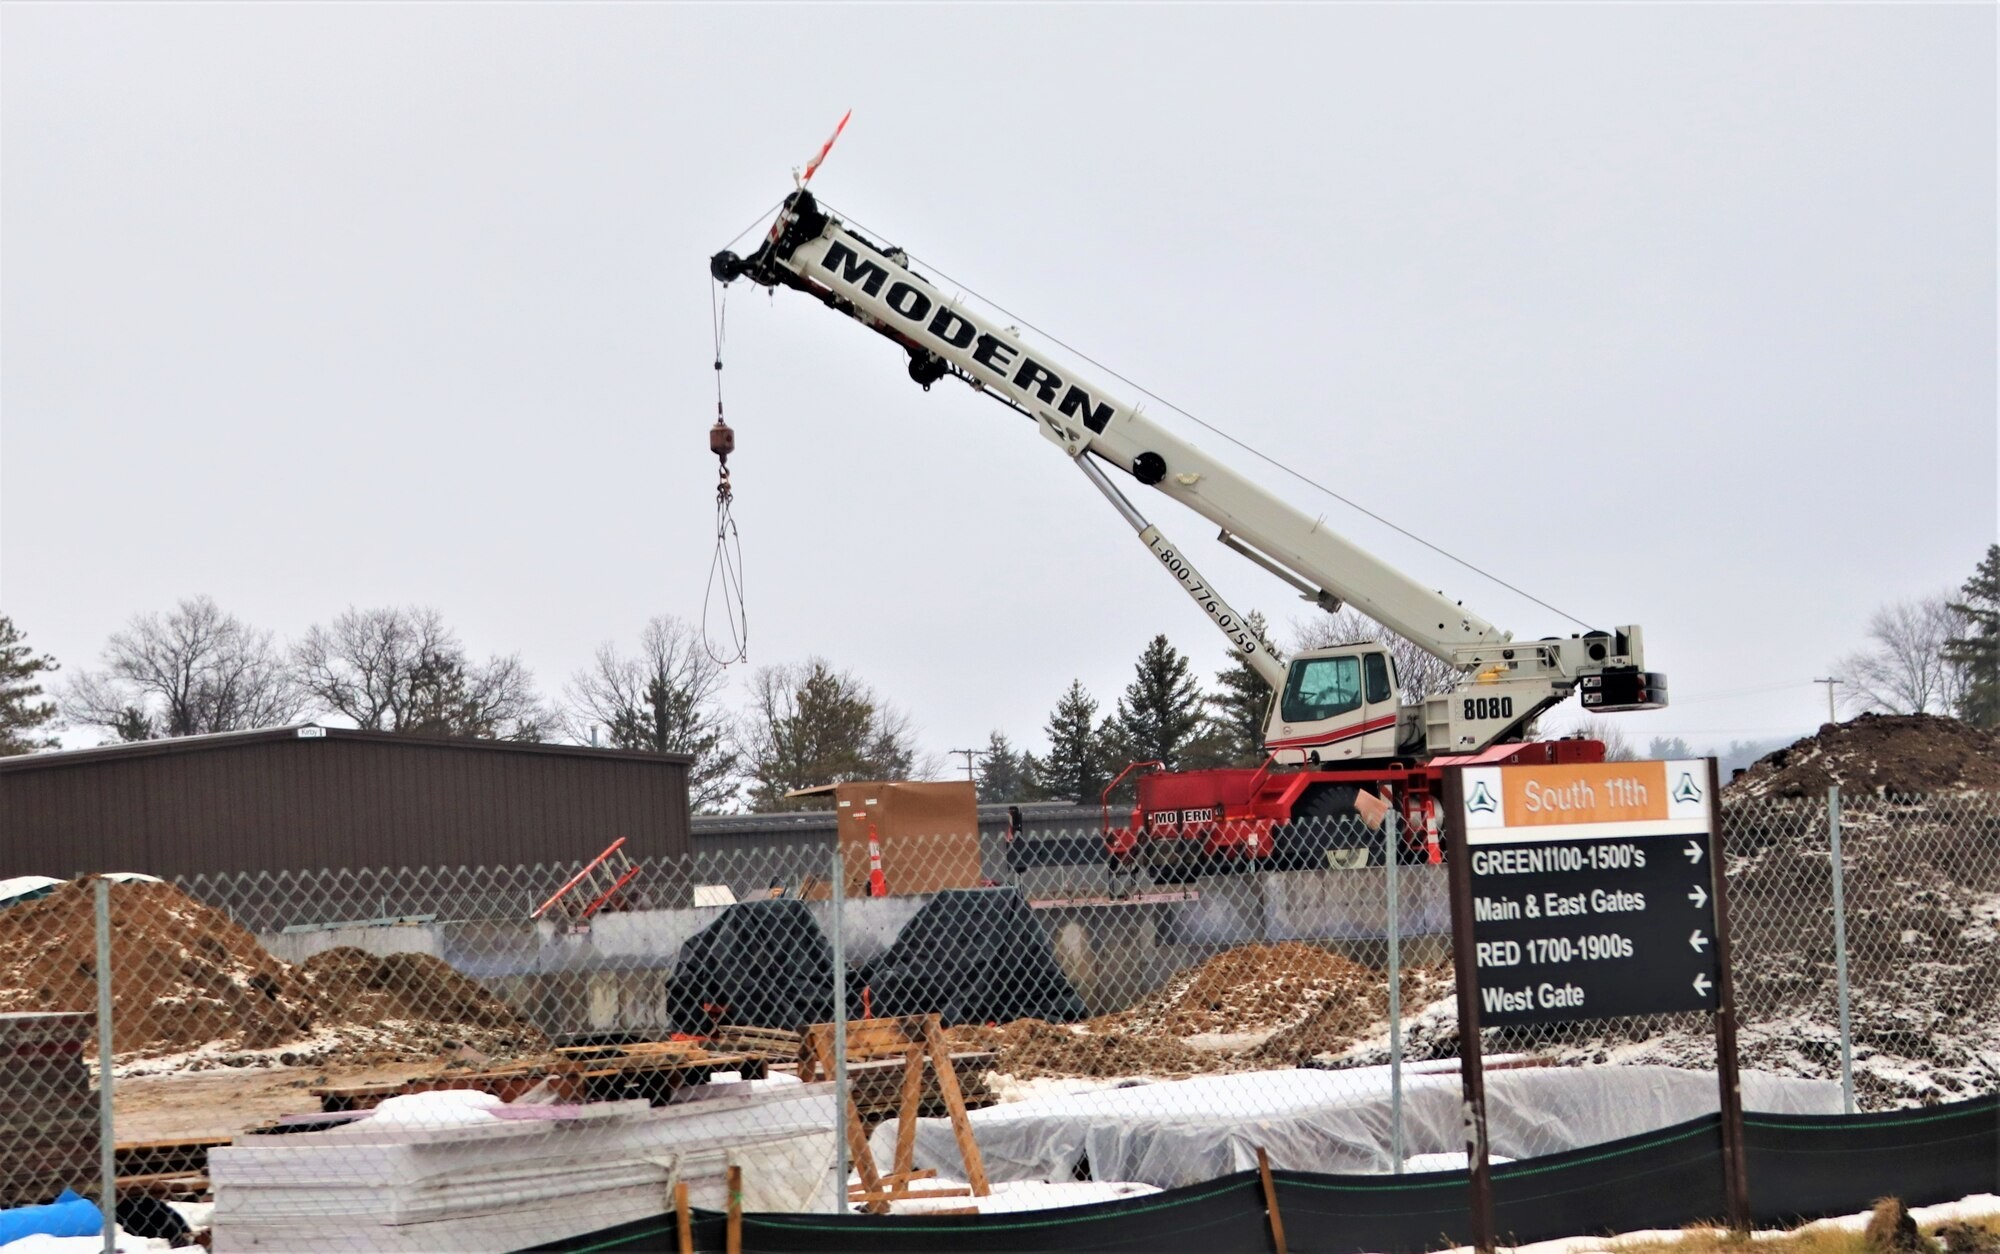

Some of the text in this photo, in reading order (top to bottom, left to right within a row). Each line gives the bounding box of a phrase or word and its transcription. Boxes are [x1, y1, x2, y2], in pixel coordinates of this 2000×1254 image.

[820, 239, 1116, 436] MODERN
[1149, 535, 1256, 655] 1-800-776-0759
[1463, 696, 1513, 721] 8080
[1524, 777, 1648, 813] South 11th
[1155, 809, 1212, 825] MOERN
[1474, 888, 1646, 922] Main & East Gates
[1476, 933, 1634, 968] RED 1700-1900s
[1481, 982, 1585, 1014] West Gate
